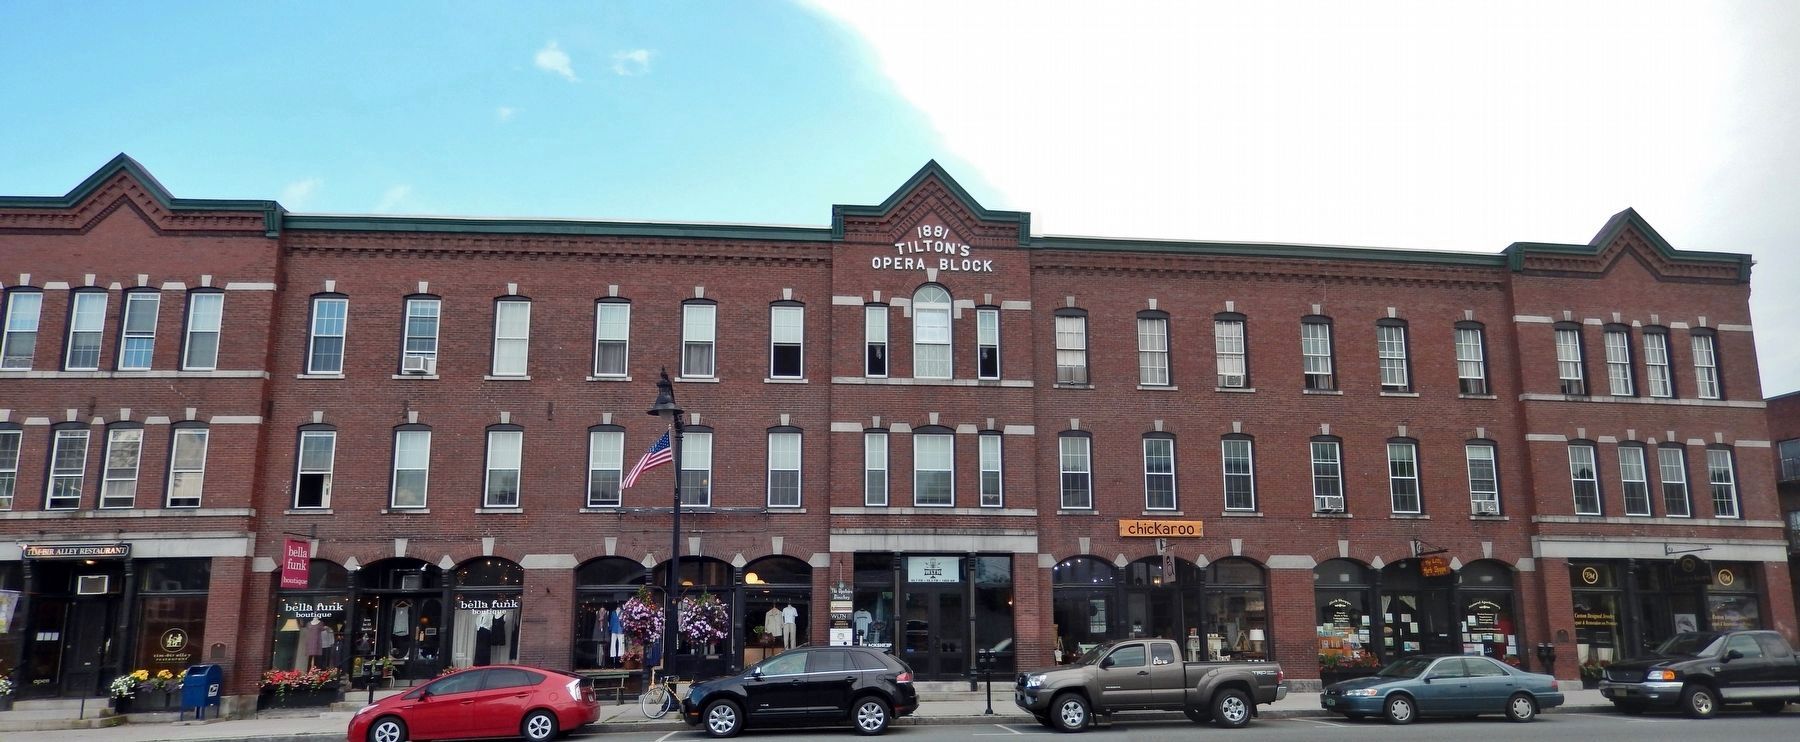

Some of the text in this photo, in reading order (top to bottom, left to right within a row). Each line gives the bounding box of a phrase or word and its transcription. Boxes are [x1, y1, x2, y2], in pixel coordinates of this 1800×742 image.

[917, 225, 949, 240] 1881
[895, 240, 970, 257] TILTON'S
[872, 257, 993, 272] OPERA BLOCK
[55, 547, 78, 555] ALLEY
[79, 546, 127, 555] RESTAURANT
[288, 545, 308, 558] bella
[287, 558, 307, 571] funk
[283, 576, 308, 585] boutique
[285, 602, 344, 612] bella funk
[461, 599, 519, 609] bella funk
[472, 608, 507, 616] boutique
